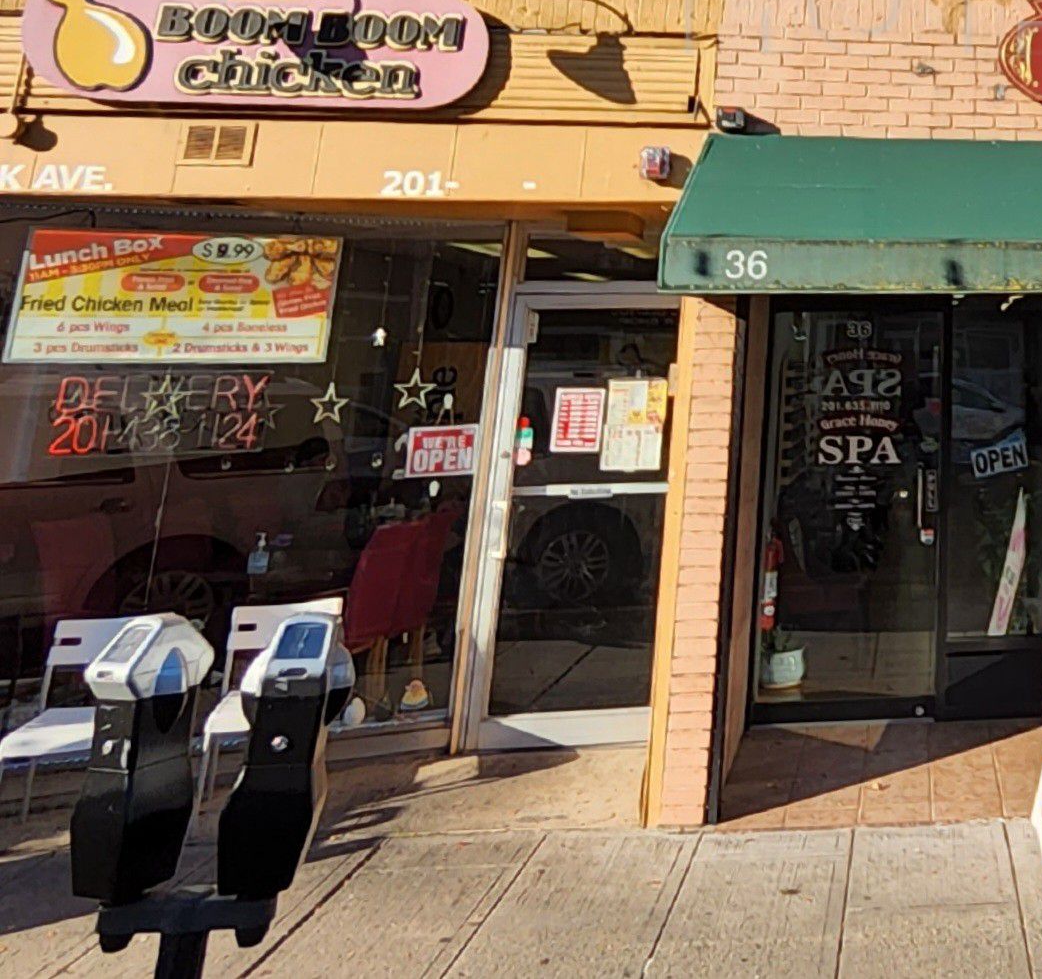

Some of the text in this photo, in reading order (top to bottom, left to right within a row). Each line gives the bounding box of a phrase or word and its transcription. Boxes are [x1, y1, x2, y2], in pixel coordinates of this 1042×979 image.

[156, 3, 466, 52] BOOM BOOM
[174, 48, 423, 99] chicken
[32, 164, 113, 191] AVE.
[380, 170, 460, 197] 201-
[30, 242, 109, 270] Lunch
[113, 235, 165, 256] Box
[725, 249, 768, 280] 36
[20, 295, 67, 312] Fried
[71, 296, 143, 313] Chicken
[149, 296, 193, 313] Meal
[56, 322, 130, 334] 6 pcs Wings
[202, 322, 288, 333] 4 pcs Boneless
[33, 342, 138, 354] 3 pcs Drumsticks
[172, 343, 181, 353] 2
[184, 342, 248, 354] Drumsticks
[265, 342, 273, 353] 3
[275, 342, 309, 354] Wings
[413, 447, 472, 472] OPEN
[818, 435, 902, 465] SPA
[975, 443, 1027, 476] OPEN
